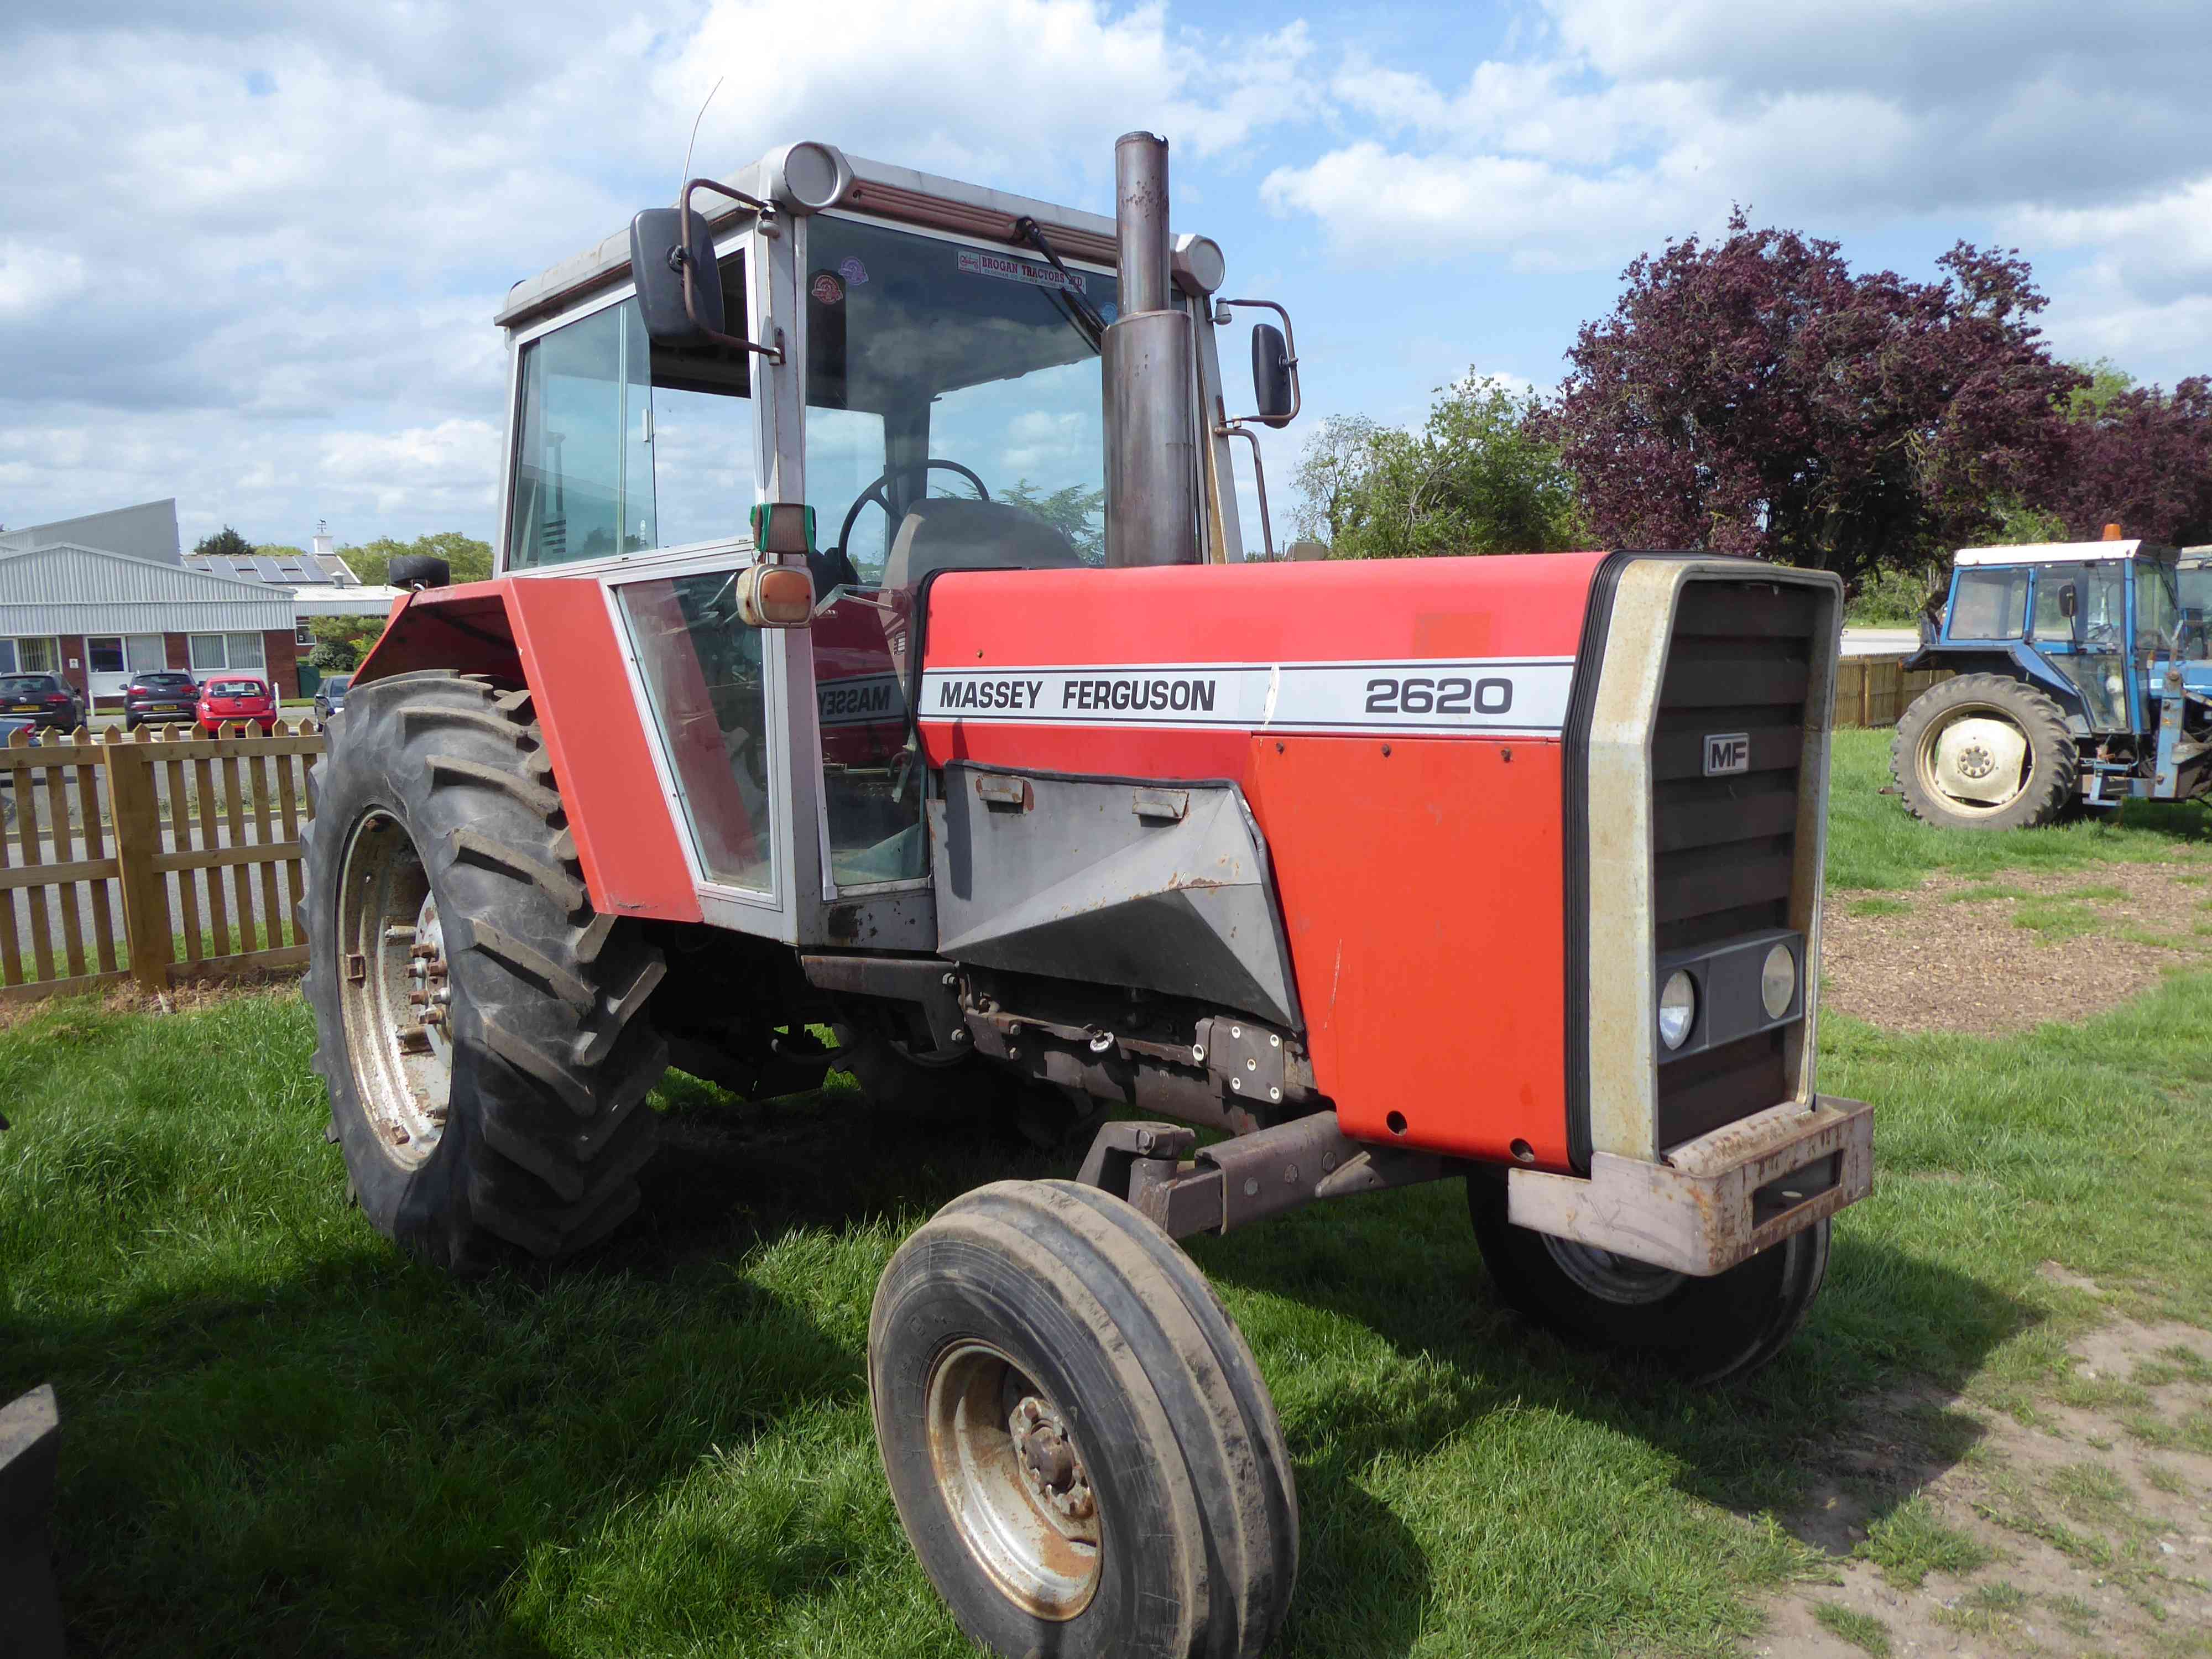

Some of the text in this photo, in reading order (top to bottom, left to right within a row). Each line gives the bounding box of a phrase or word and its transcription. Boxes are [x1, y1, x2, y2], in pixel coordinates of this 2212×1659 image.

[982, 257, 1018, 274] BROGAN
[1021, 265, 1065, 284] TRACTORS
[940, 680, 1216, 711] MASSEY FERGUSON
[1365, 677, 1513, 714] 2620
[1711, 741, 1747, 769] MF
